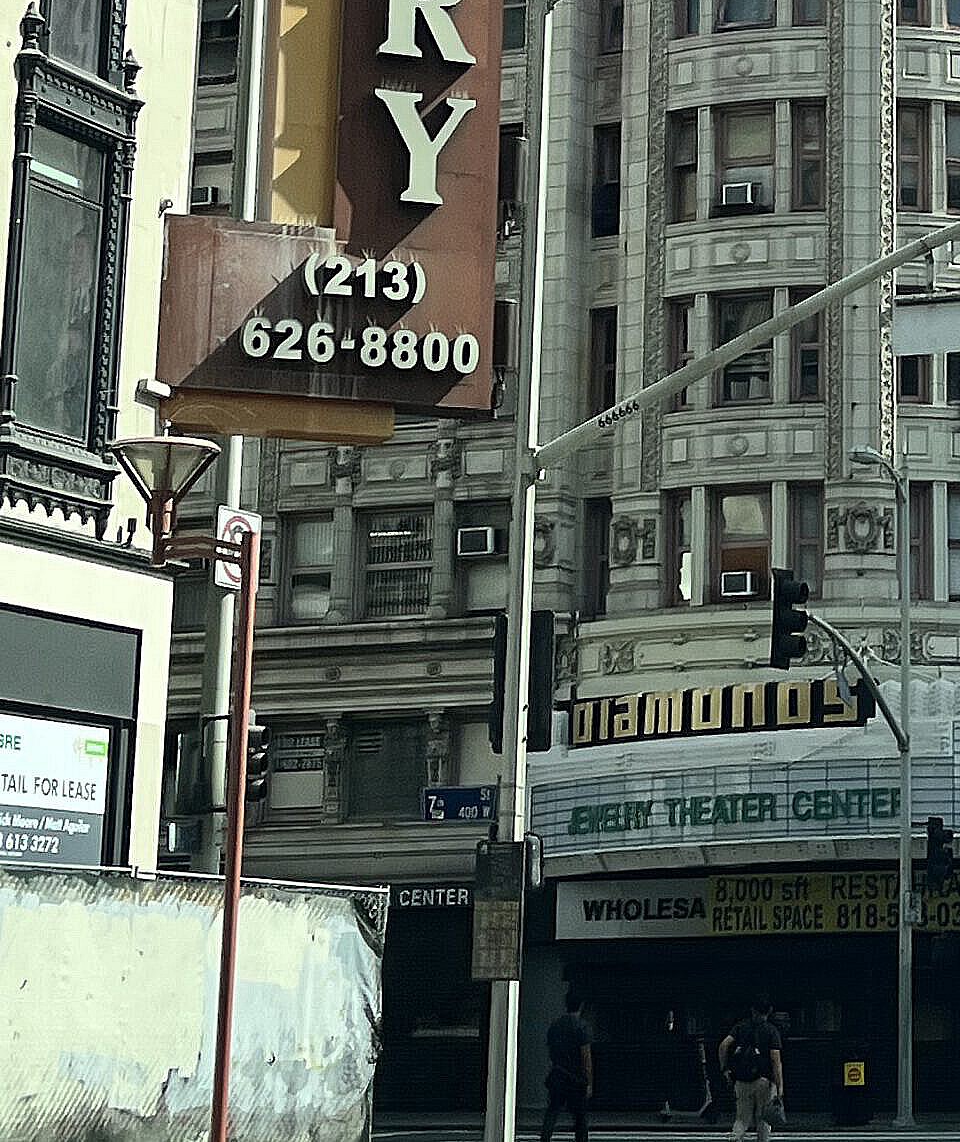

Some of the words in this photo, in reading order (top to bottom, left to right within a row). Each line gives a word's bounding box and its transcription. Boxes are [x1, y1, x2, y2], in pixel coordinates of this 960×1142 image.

[305, 251, 427, 304] (213)
[242, 316, 480, 374] 626-8800
[34, 776, 58, 797] FOR
[62, 779, 97, 801] LEASE
[665, 791, 776, 827] THEATER
[400, 889, 469, 907] CENTER
[583, 898, 707, 922] WHOLESA
[712, 905, 768, 932] RETAIL
[772, 903, 823, 930] SPACE
